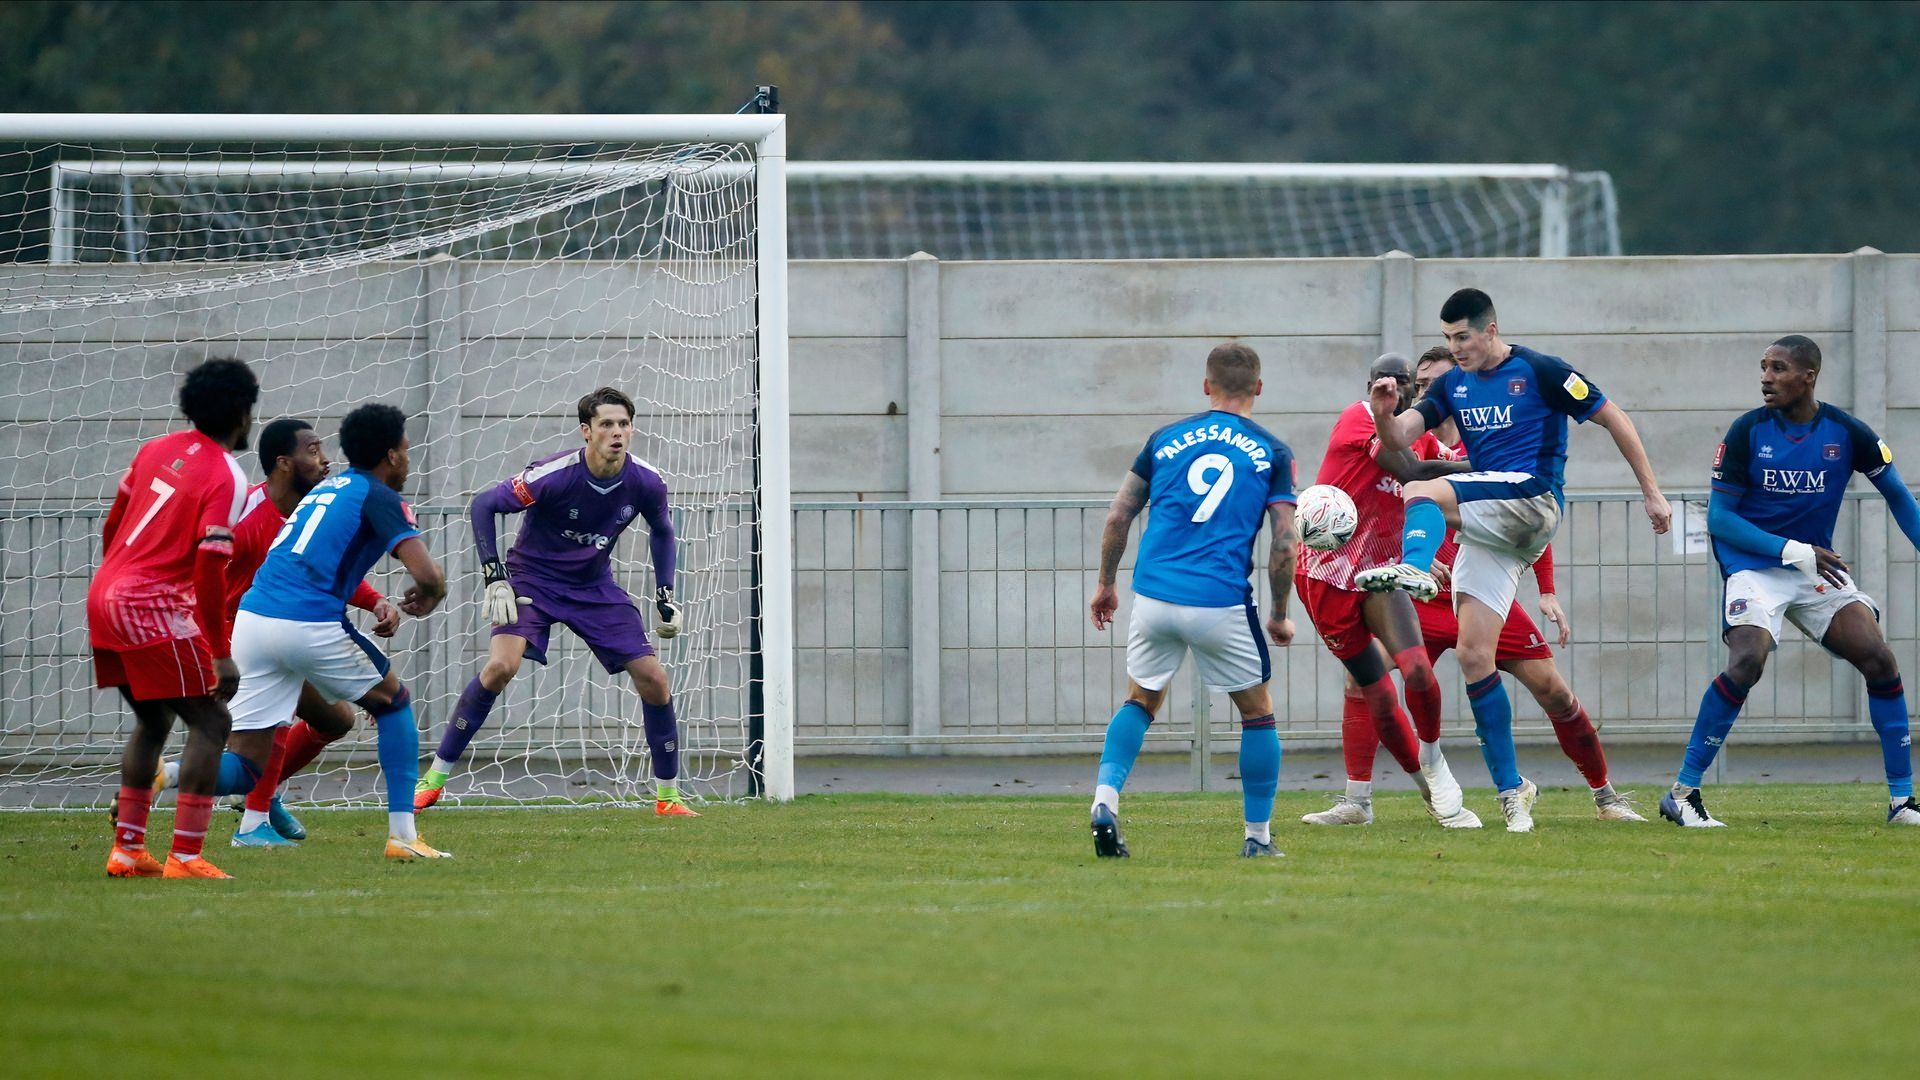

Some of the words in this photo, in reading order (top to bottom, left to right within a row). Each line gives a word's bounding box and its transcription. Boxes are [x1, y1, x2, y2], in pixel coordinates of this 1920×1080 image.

[1459, 404, 1514, 426] EWM
[1161, 424, 1271, 474] ALESSANDRA
[1187, 453, 1234, 522] 9
[1762, 469, 1828, 488] EWM
[125, 477, 176, 547] 7
